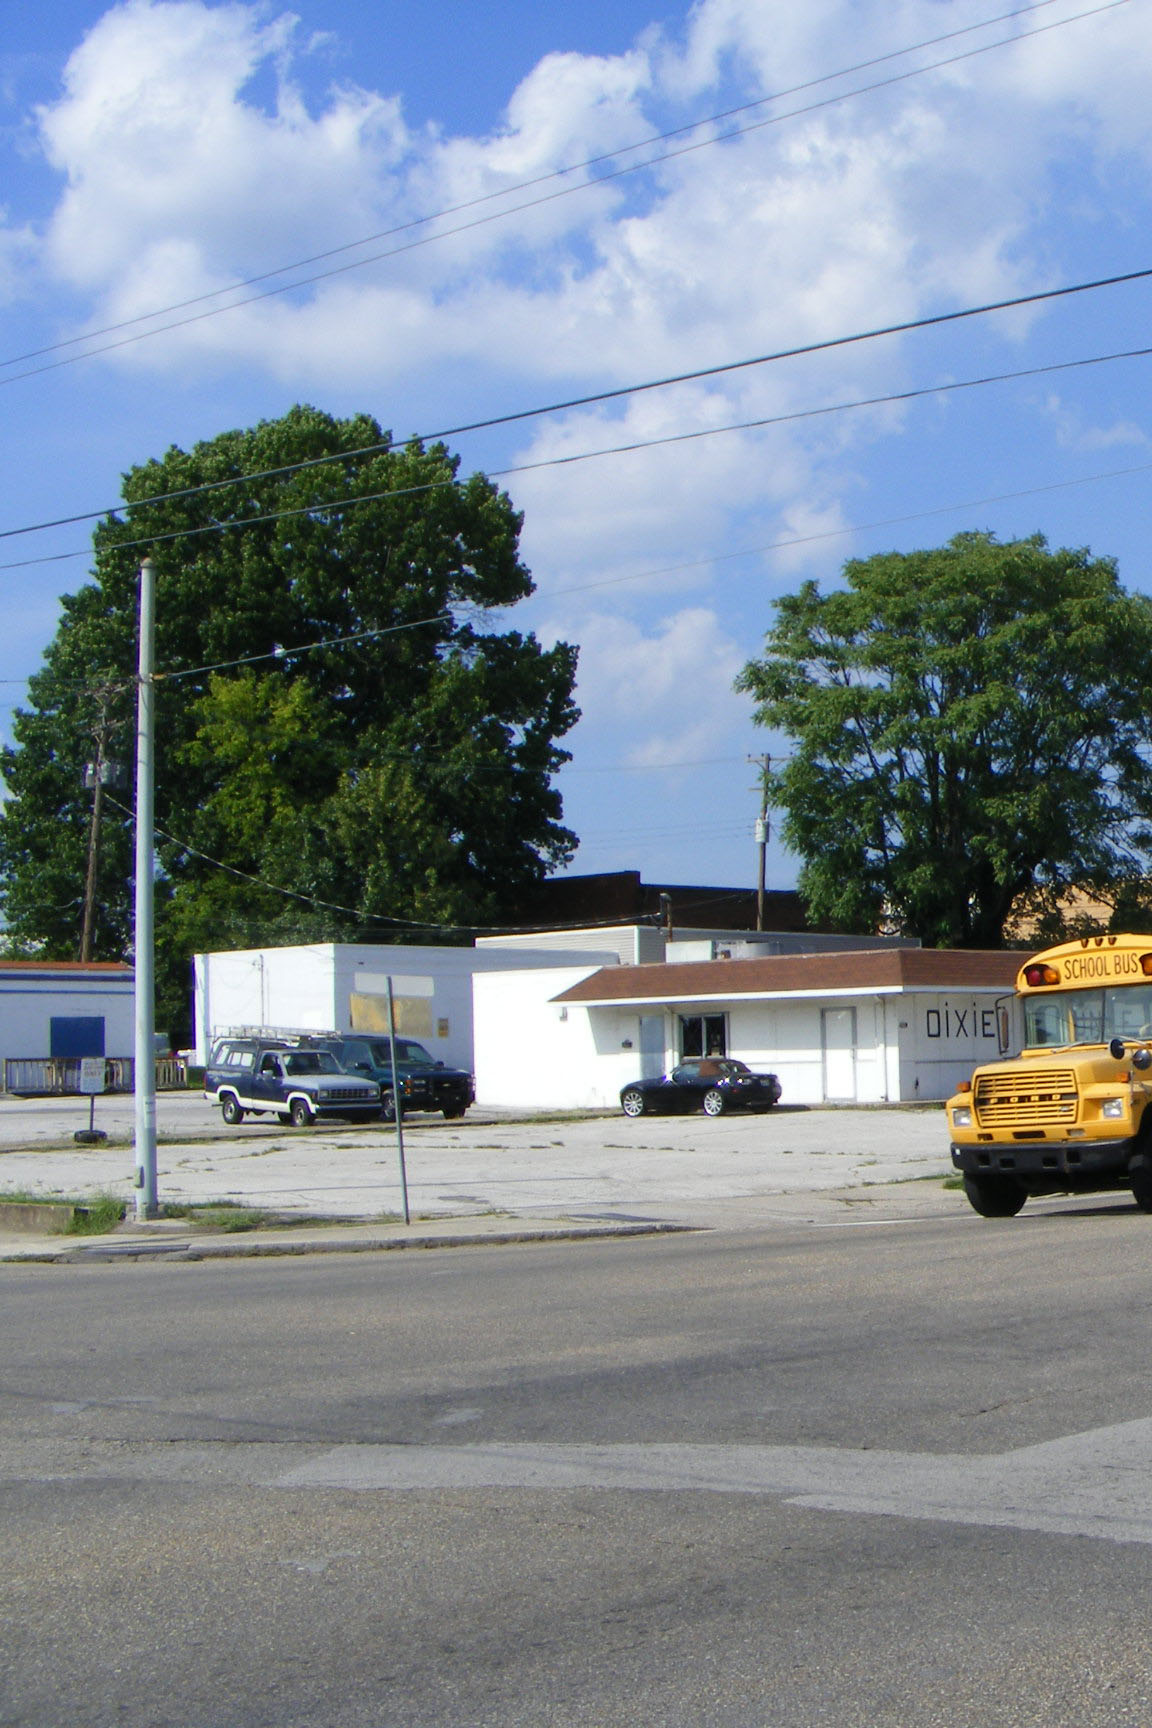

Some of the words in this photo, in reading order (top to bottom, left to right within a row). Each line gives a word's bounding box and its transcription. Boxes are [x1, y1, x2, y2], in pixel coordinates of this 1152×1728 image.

[1064, 956, 1111, 980] SCHOOL
[1114, 952, 1139, 975] BUS
[990, 1094, 1061, 1105] FORD
